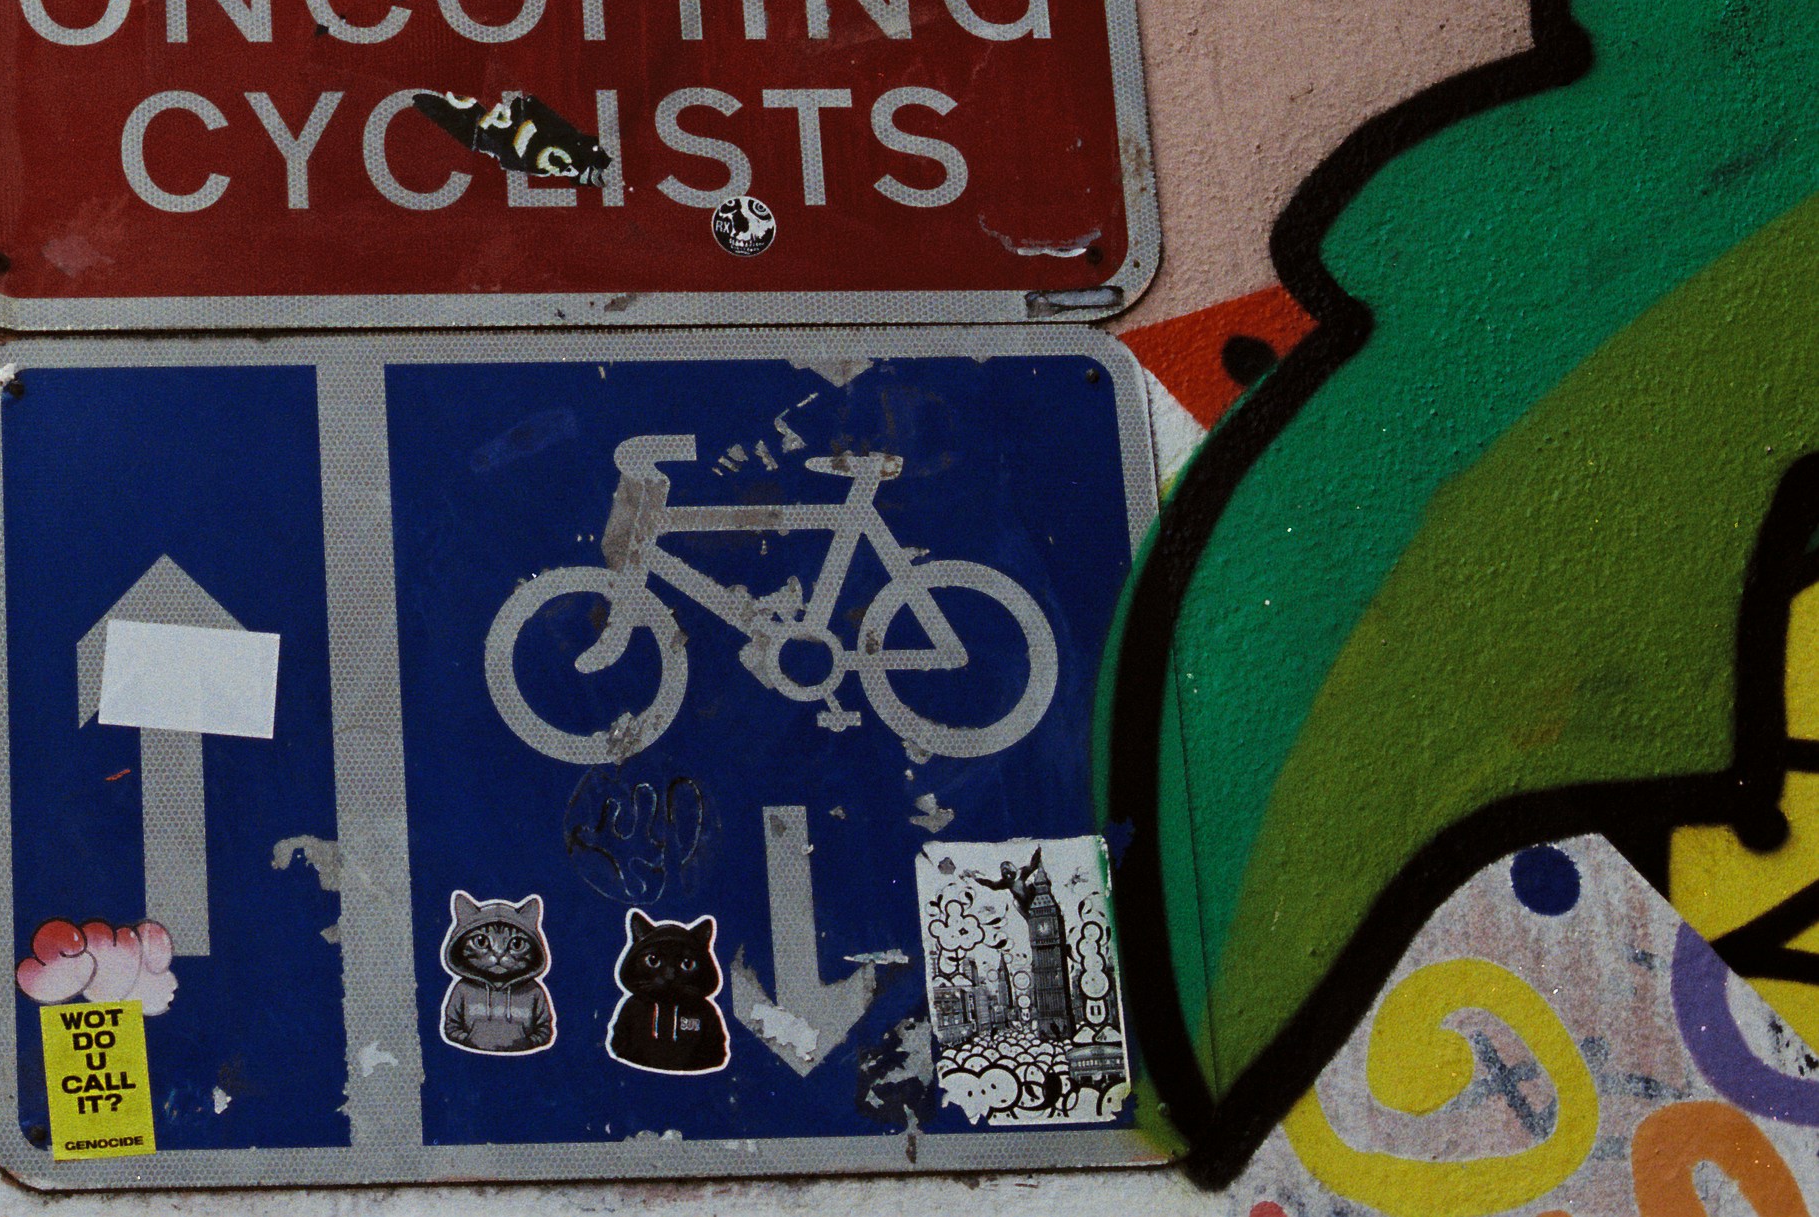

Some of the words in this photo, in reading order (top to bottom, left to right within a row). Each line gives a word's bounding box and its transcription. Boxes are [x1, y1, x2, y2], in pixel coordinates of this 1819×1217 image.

[120, 86, 970, 214] CYCLISTS
[60, 1008, 124, 1031] WOT
[72, 1030, 116, 1051] DO
[85, 1052, 107, 1072] U
[61, 1071, 137, 1095] CALL
[77, 1093, 124, 1115] IT?
[64, 1135, 145, 1152] GENOCIDE
